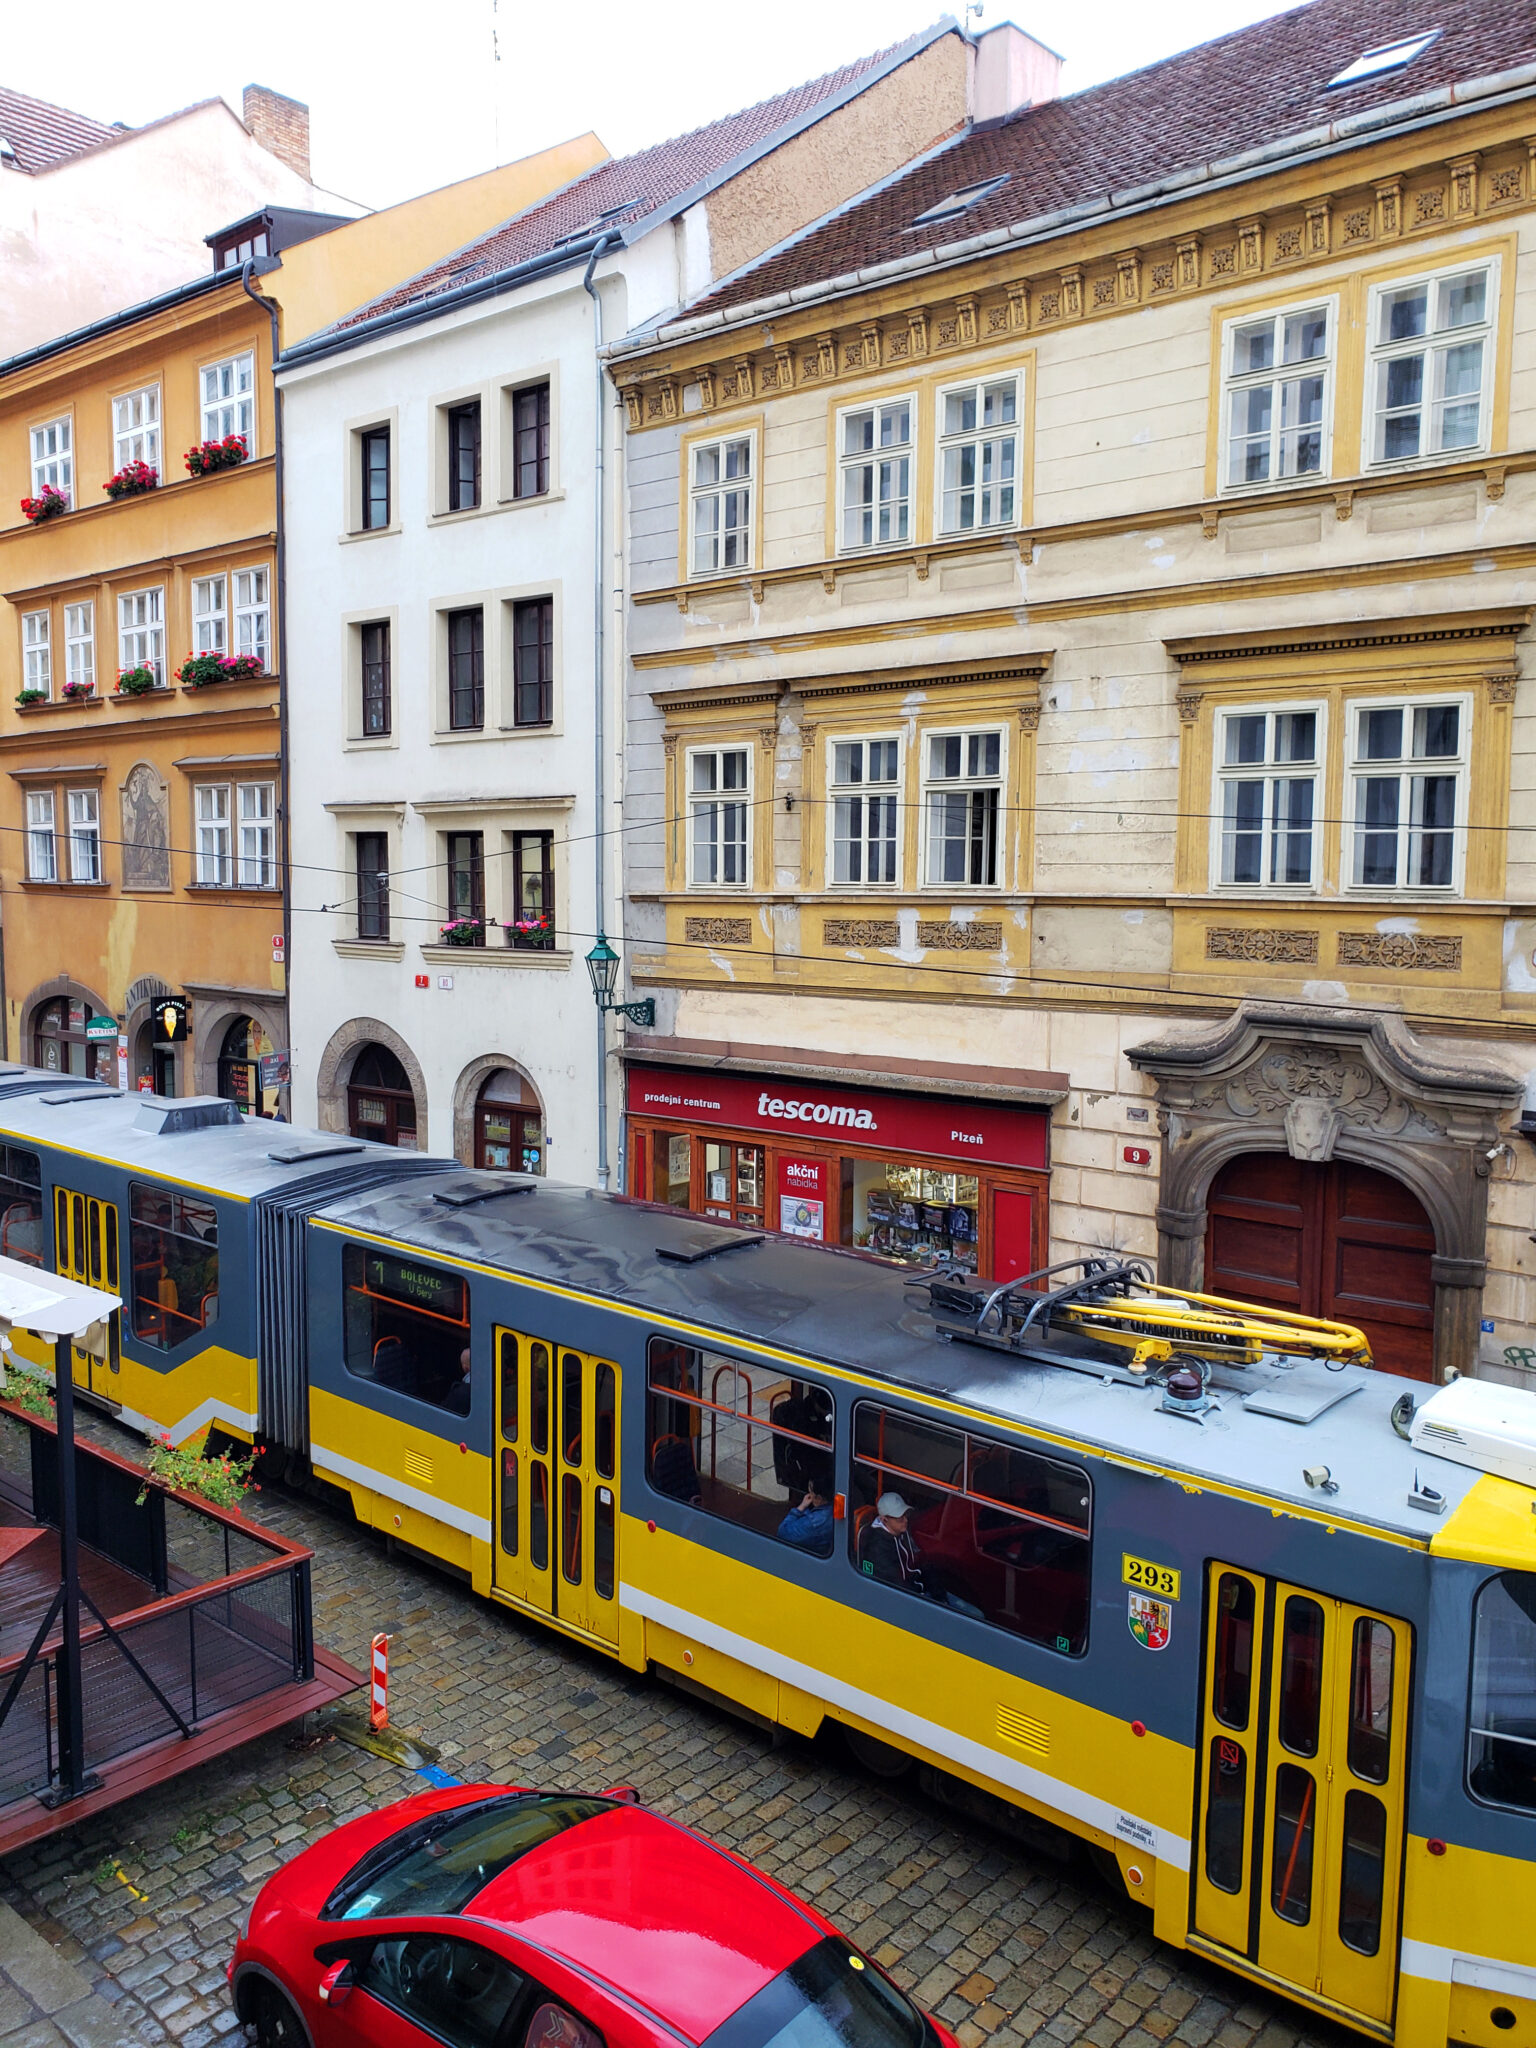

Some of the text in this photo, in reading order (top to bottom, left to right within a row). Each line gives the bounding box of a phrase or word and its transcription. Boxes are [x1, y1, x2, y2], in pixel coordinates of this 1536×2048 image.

[644, 1093, 721, 1110] prodejní centrum
[951, 1130, 984, 1145] Plzeň
[1132, 1150, 1140, 1162] 9
[787, 1163, 819, 1180] akční
[786, 1177, 818, 1190] nabídka
[374, 1261, 384, 1285] 1
[400, 1268, 442, 1290] BOLEVEC
[1128, 1561, 1174, 1593] 293
